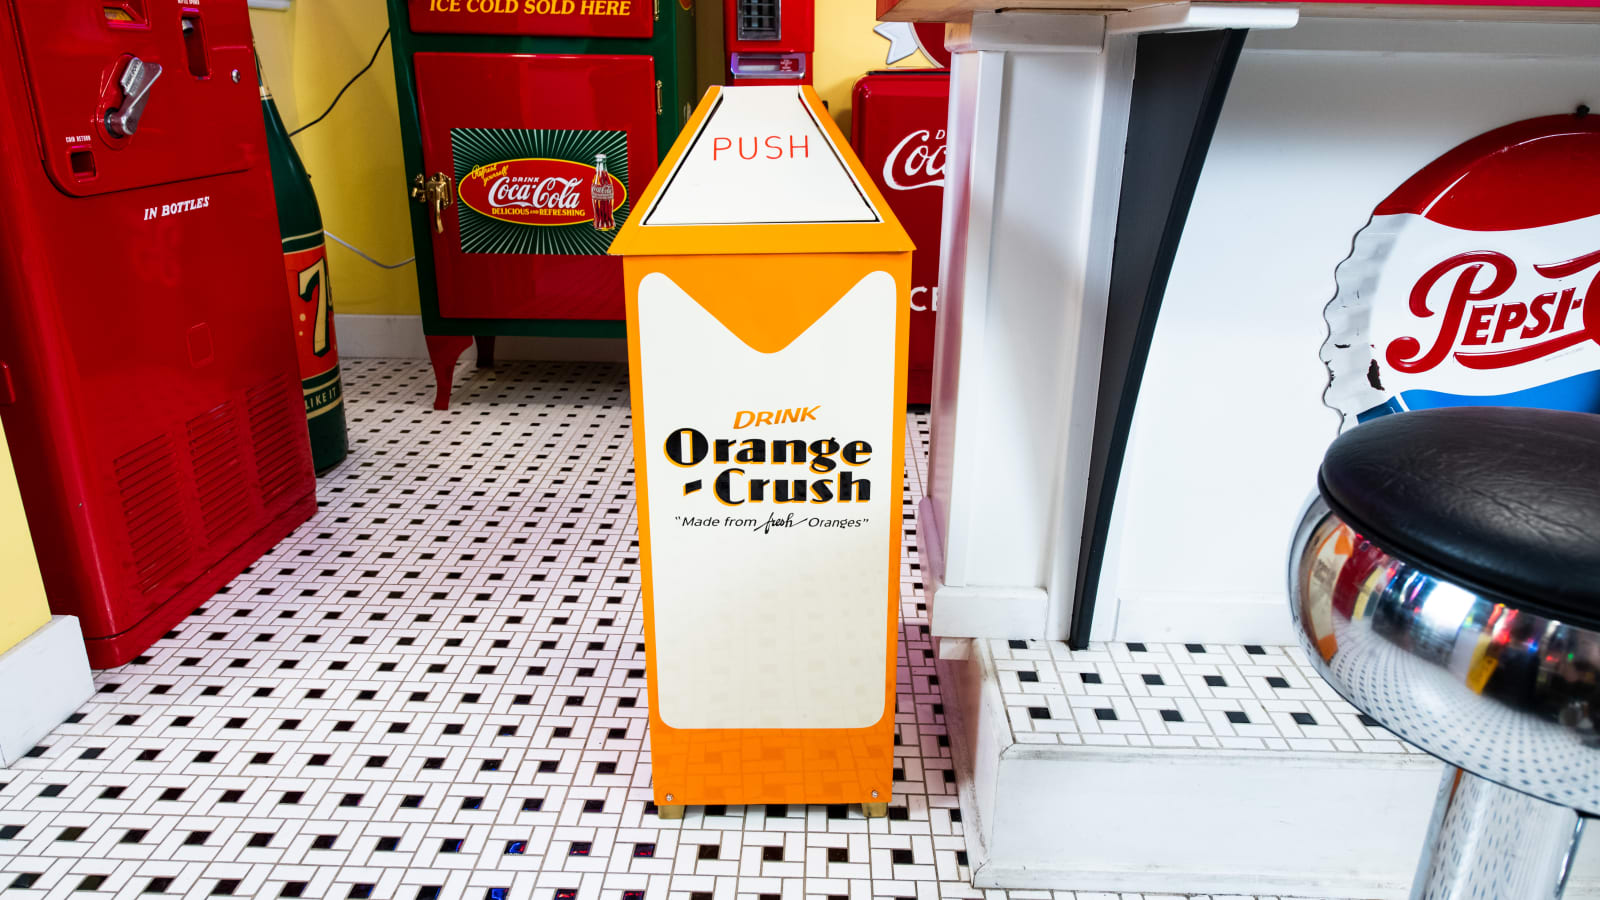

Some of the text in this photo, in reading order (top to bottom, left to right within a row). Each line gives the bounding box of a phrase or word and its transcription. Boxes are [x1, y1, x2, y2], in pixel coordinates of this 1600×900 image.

[429, 0, 632, 16] ICE COLD SOLD HERE
[713, 134, 809, 161] PUSH
[487, 176, 583, 209] Coca-Cola
[143, 195, 210, 221] IN BOTTLES
[491, 207, 530, 216] DELICIOUS
[539, 208, 586, 217] REFRESHING
[304, 386, 336, 410] LIKE IT
[733, 405, 821, 430] DRINK
[663, 427, 873, 474] Orange
[724, 516, 757, 527] from
[753, 511, 808, 535] fresh
